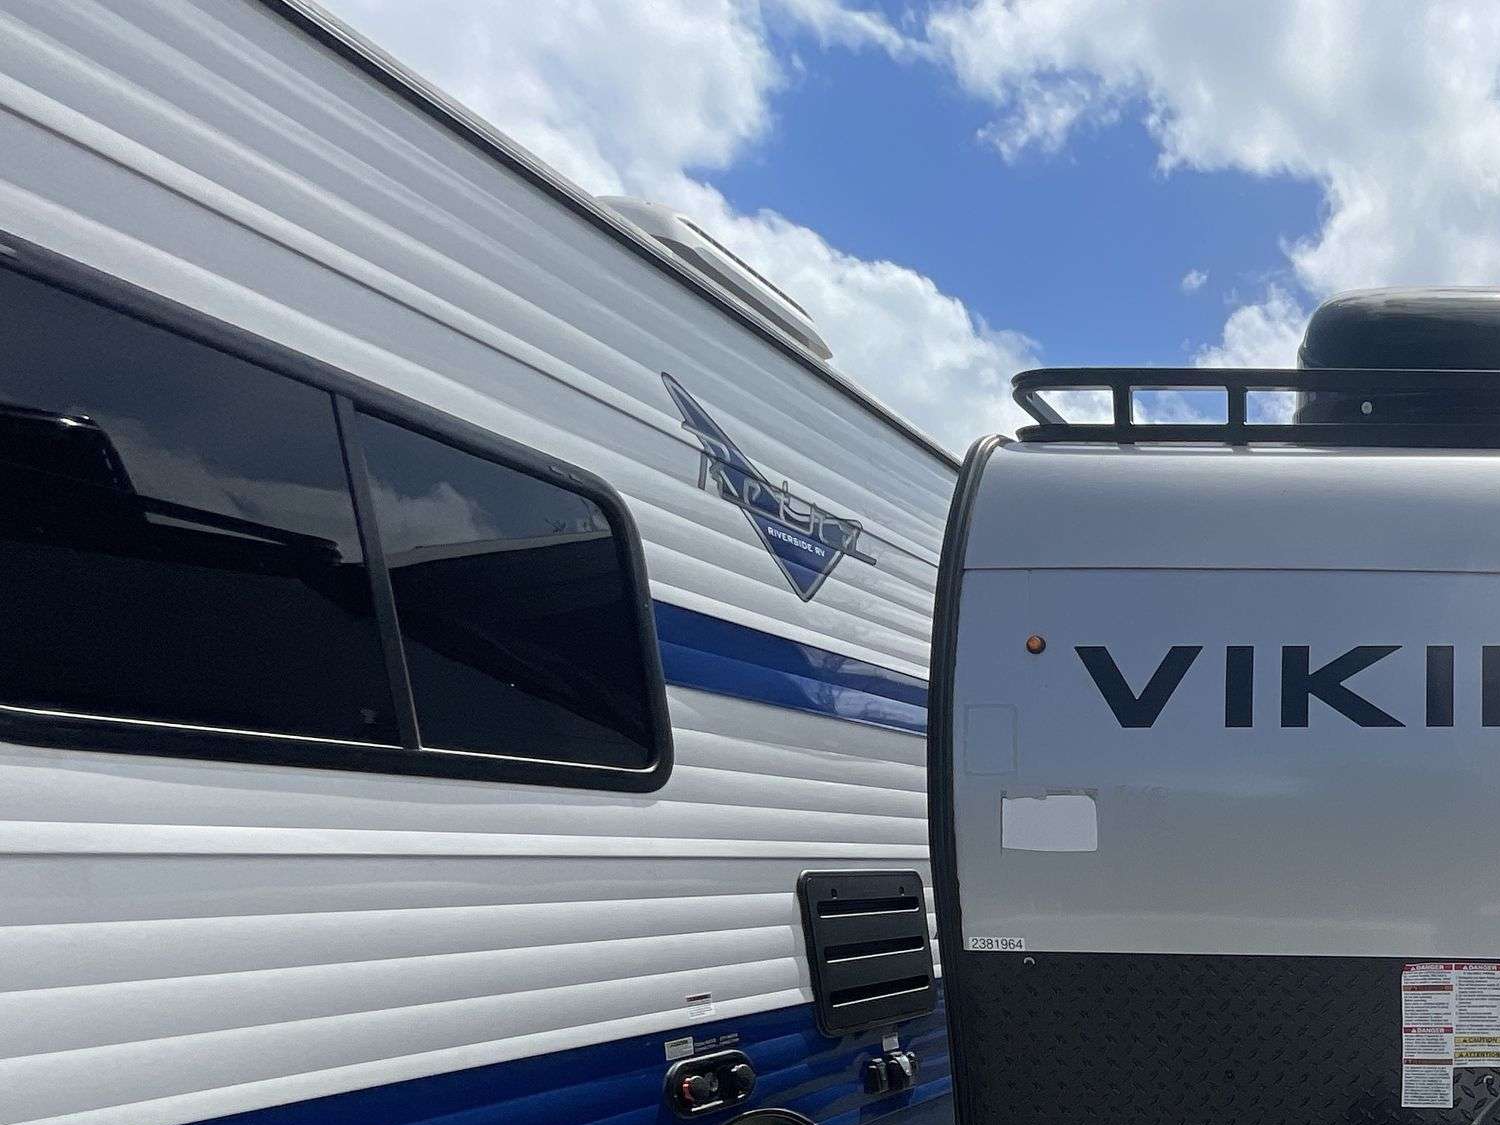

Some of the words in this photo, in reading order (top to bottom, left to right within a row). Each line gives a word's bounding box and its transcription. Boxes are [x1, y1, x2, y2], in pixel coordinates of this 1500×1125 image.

[767, 526, 813, 553] RIVERSIDE
[814, 546, 825, 557] RV
[971, 938, 1023, 950] 2381964
